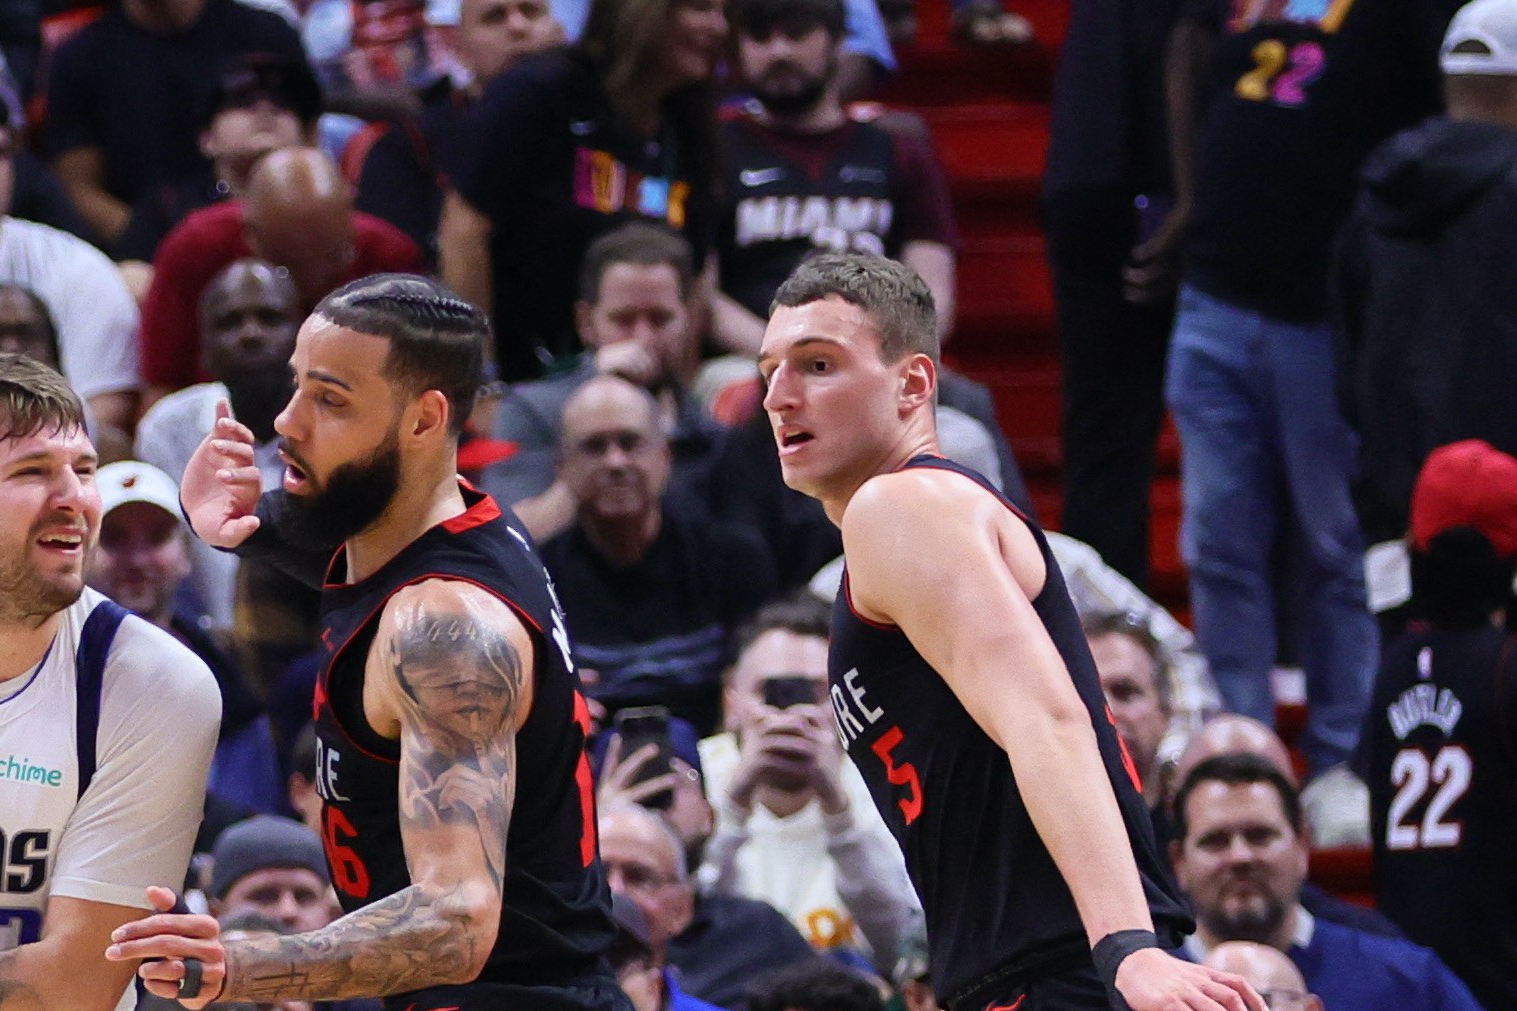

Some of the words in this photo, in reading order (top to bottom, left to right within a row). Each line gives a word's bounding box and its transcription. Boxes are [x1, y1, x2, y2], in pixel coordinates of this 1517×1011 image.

[1234, 38, 1326, 105] 22
[736, 195, 894, 246] MIAMI
[1385, 745, 1474, 850] 22
